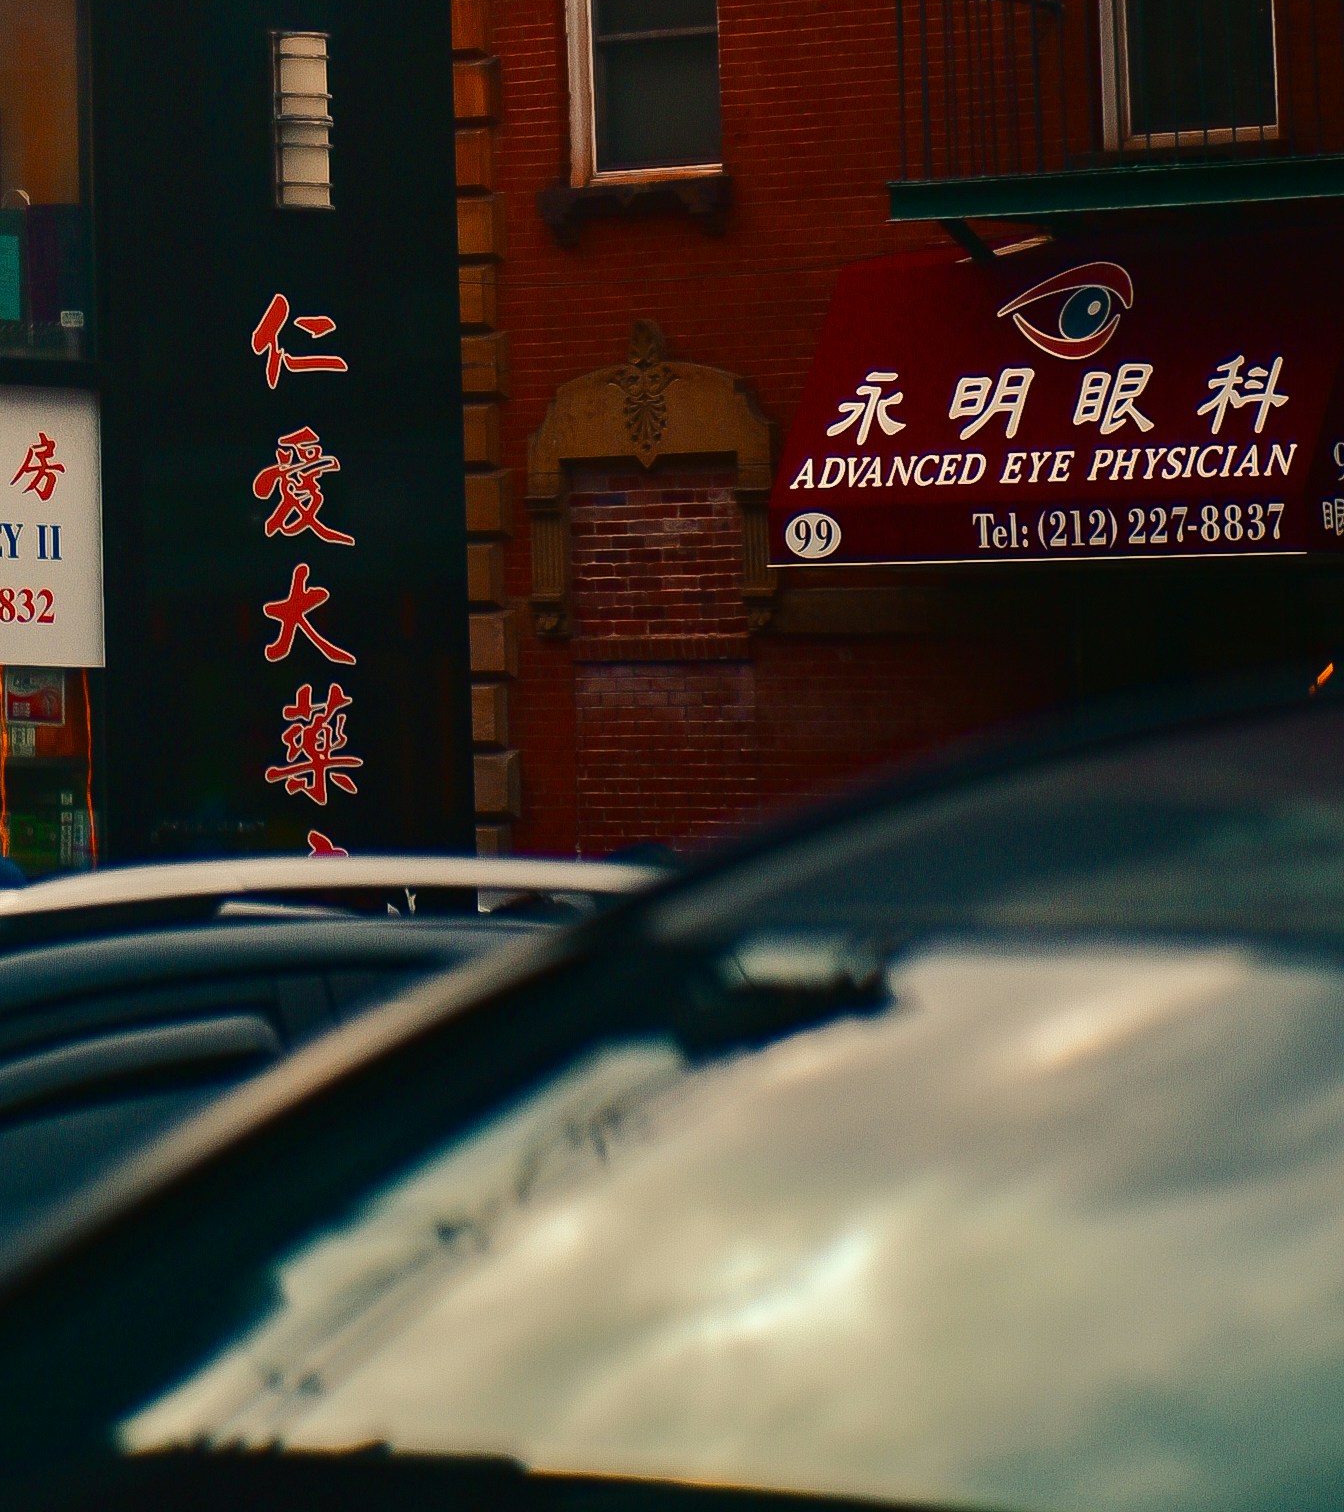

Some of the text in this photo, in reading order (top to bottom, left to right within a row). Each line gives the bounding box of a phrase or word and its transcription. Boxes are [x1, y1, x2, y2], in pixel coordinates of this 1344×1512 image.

[826, 354, 1290, 447] 永明眼科
[788, 453, 989, 491] ADVANCED
[998, 449, 1076, 485] EYE
[1086, 442, 1299, 482] PHYSICIAN
[36, 524, 63, 561] II
[791, 502, 1286, 551] 99 Tel: (212) 227-8837
[251, 292, 365, 858] 仁愛大藥
